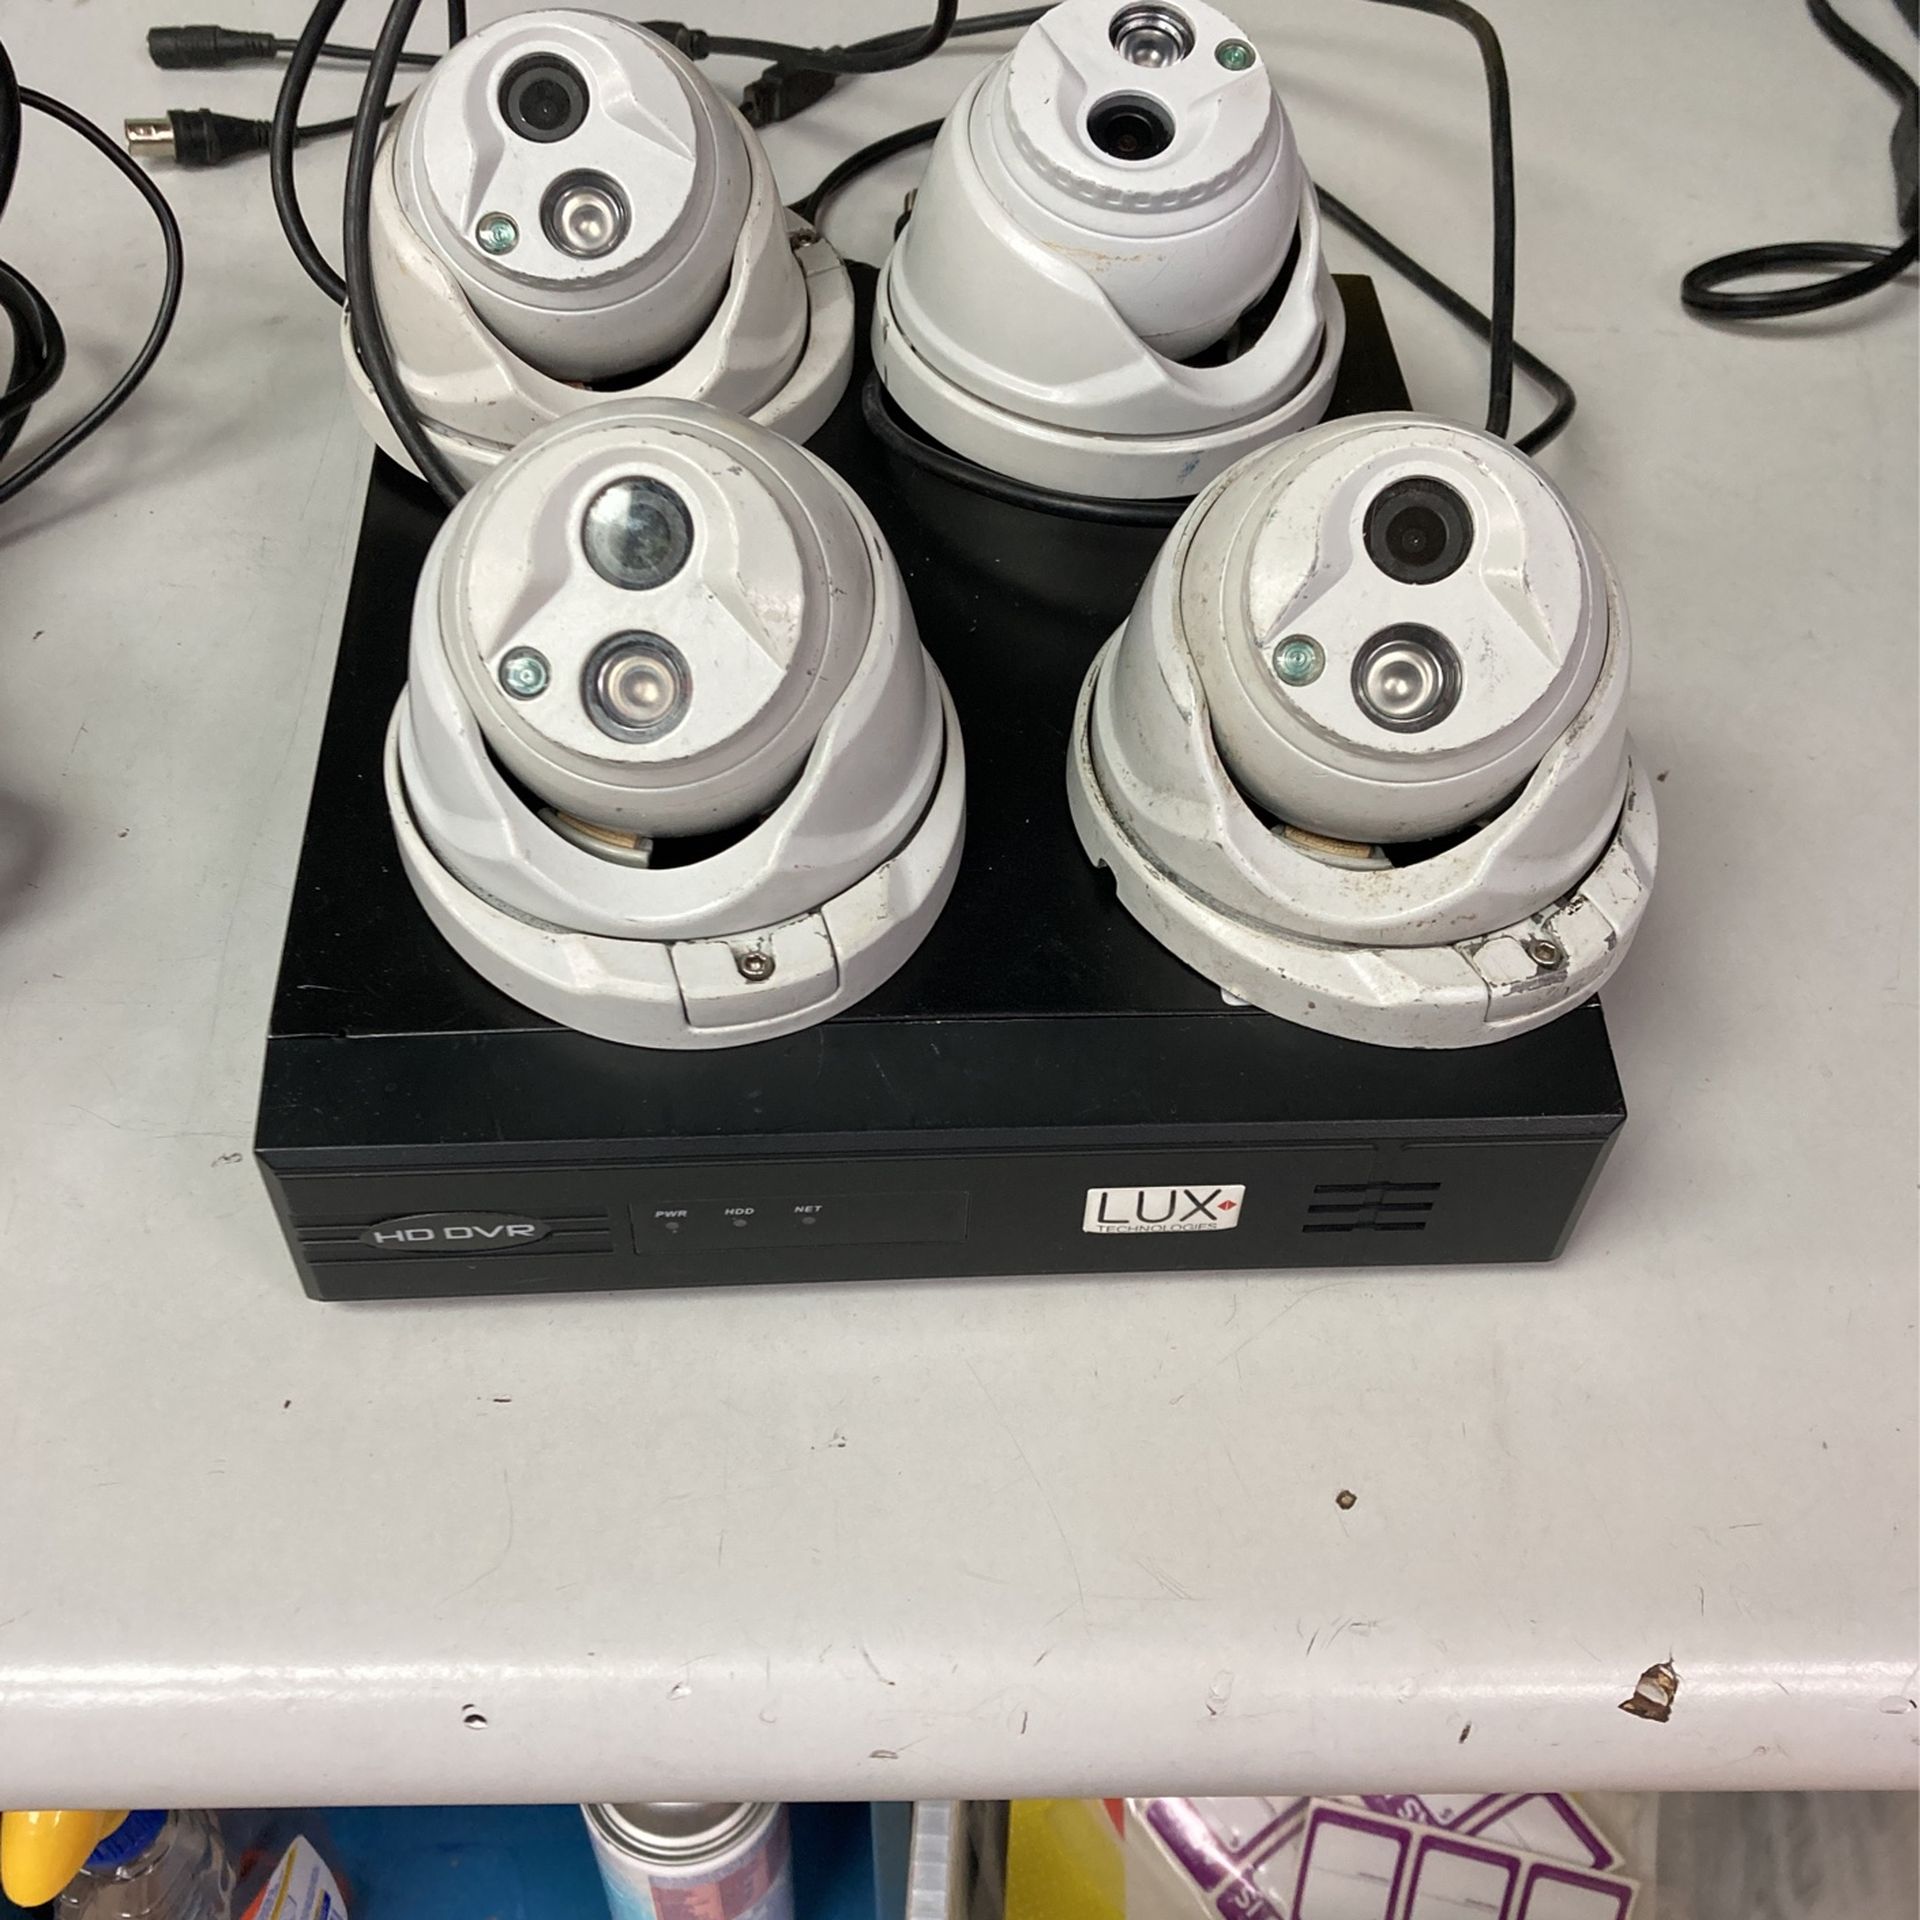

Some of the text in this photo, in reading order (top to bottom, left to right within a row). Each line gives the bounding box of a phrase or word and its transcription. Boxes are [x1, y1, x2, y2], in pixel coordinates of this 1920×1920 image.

[794, 1205, 823, 1213] NET
[1097, 1188, 1222, 1223] LUX
[654, 1210, 688, 1218] PWR
[724, 1207, 755, 1216] HDD
[1096, 1222, 1218, 1233] TECHNOLOGIES
[374, 1224, 536, 1243] HD DVR
